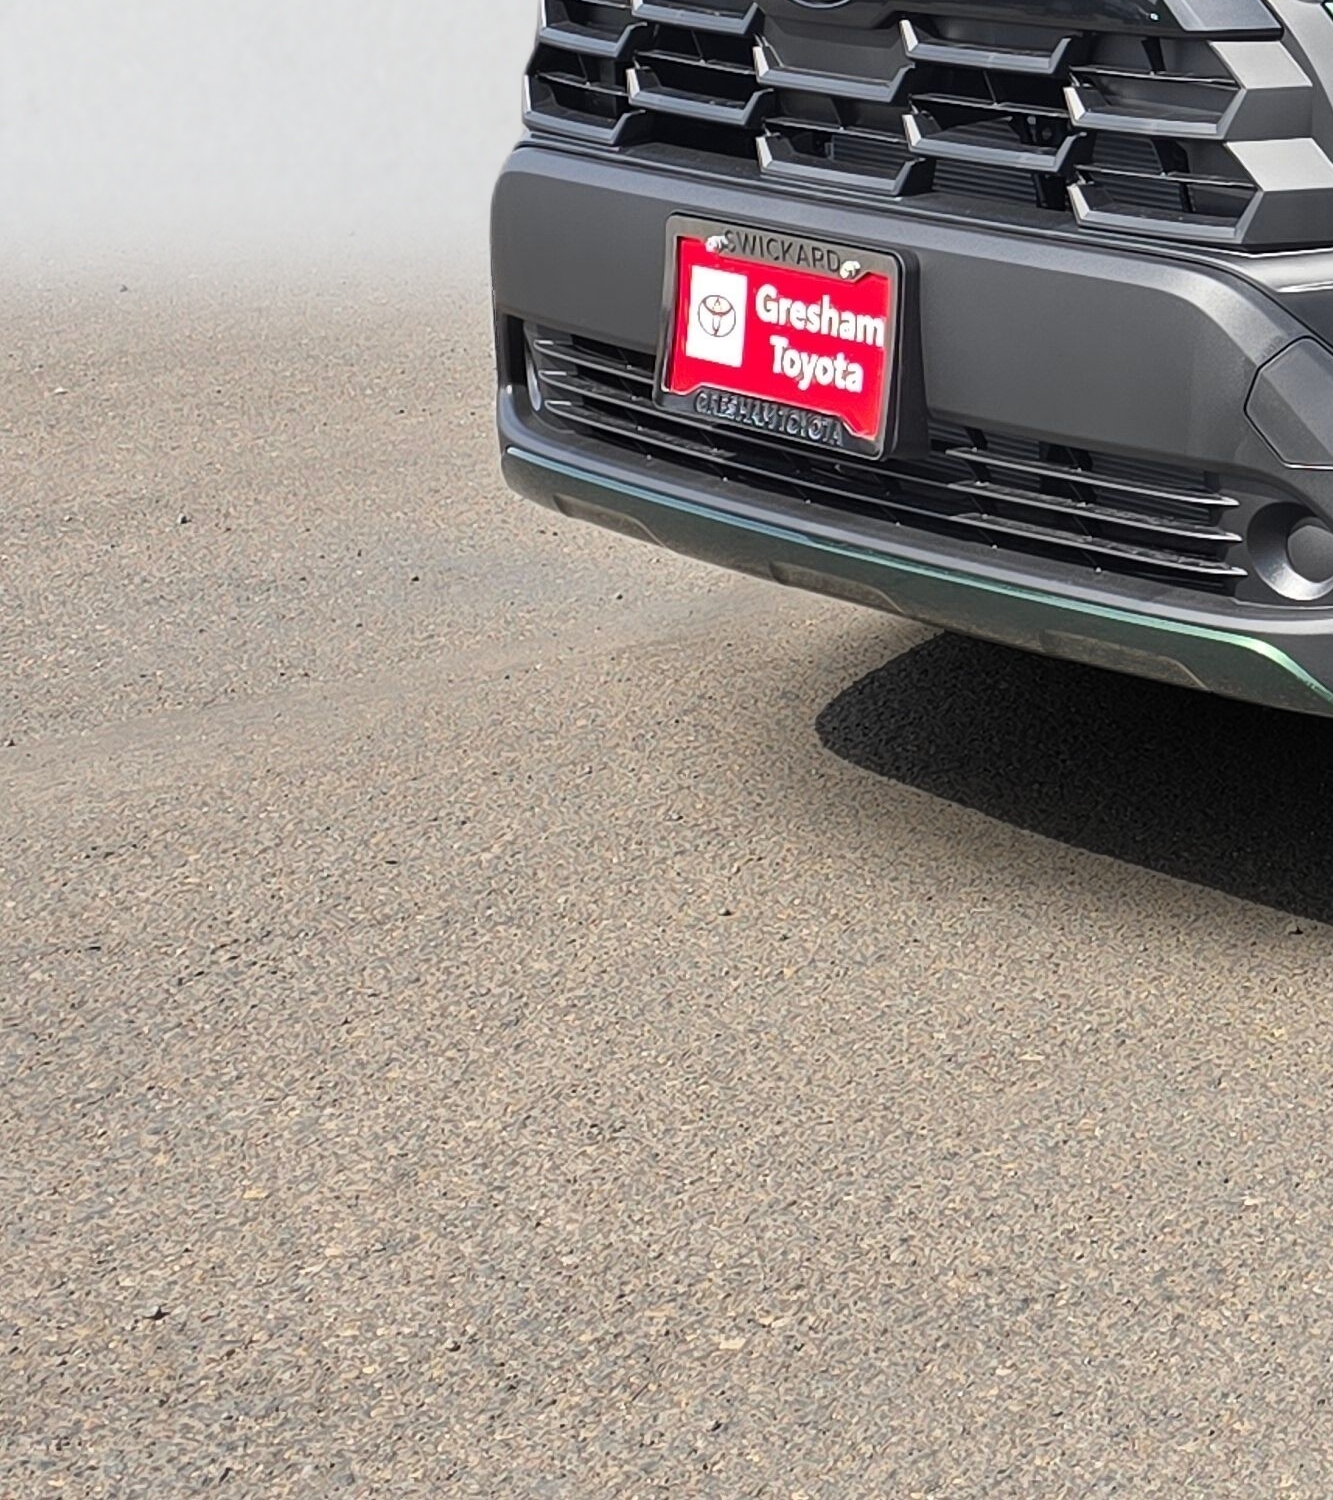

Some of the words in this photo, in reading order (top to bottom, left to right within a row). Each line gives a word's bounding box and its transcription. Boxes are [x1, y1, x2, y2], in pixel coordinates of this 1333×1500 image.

[723, 229, 843, 273] SWICKARD
[755, 283, 886, 348] Gresham
[769, 334, 865, 393] Toyota
